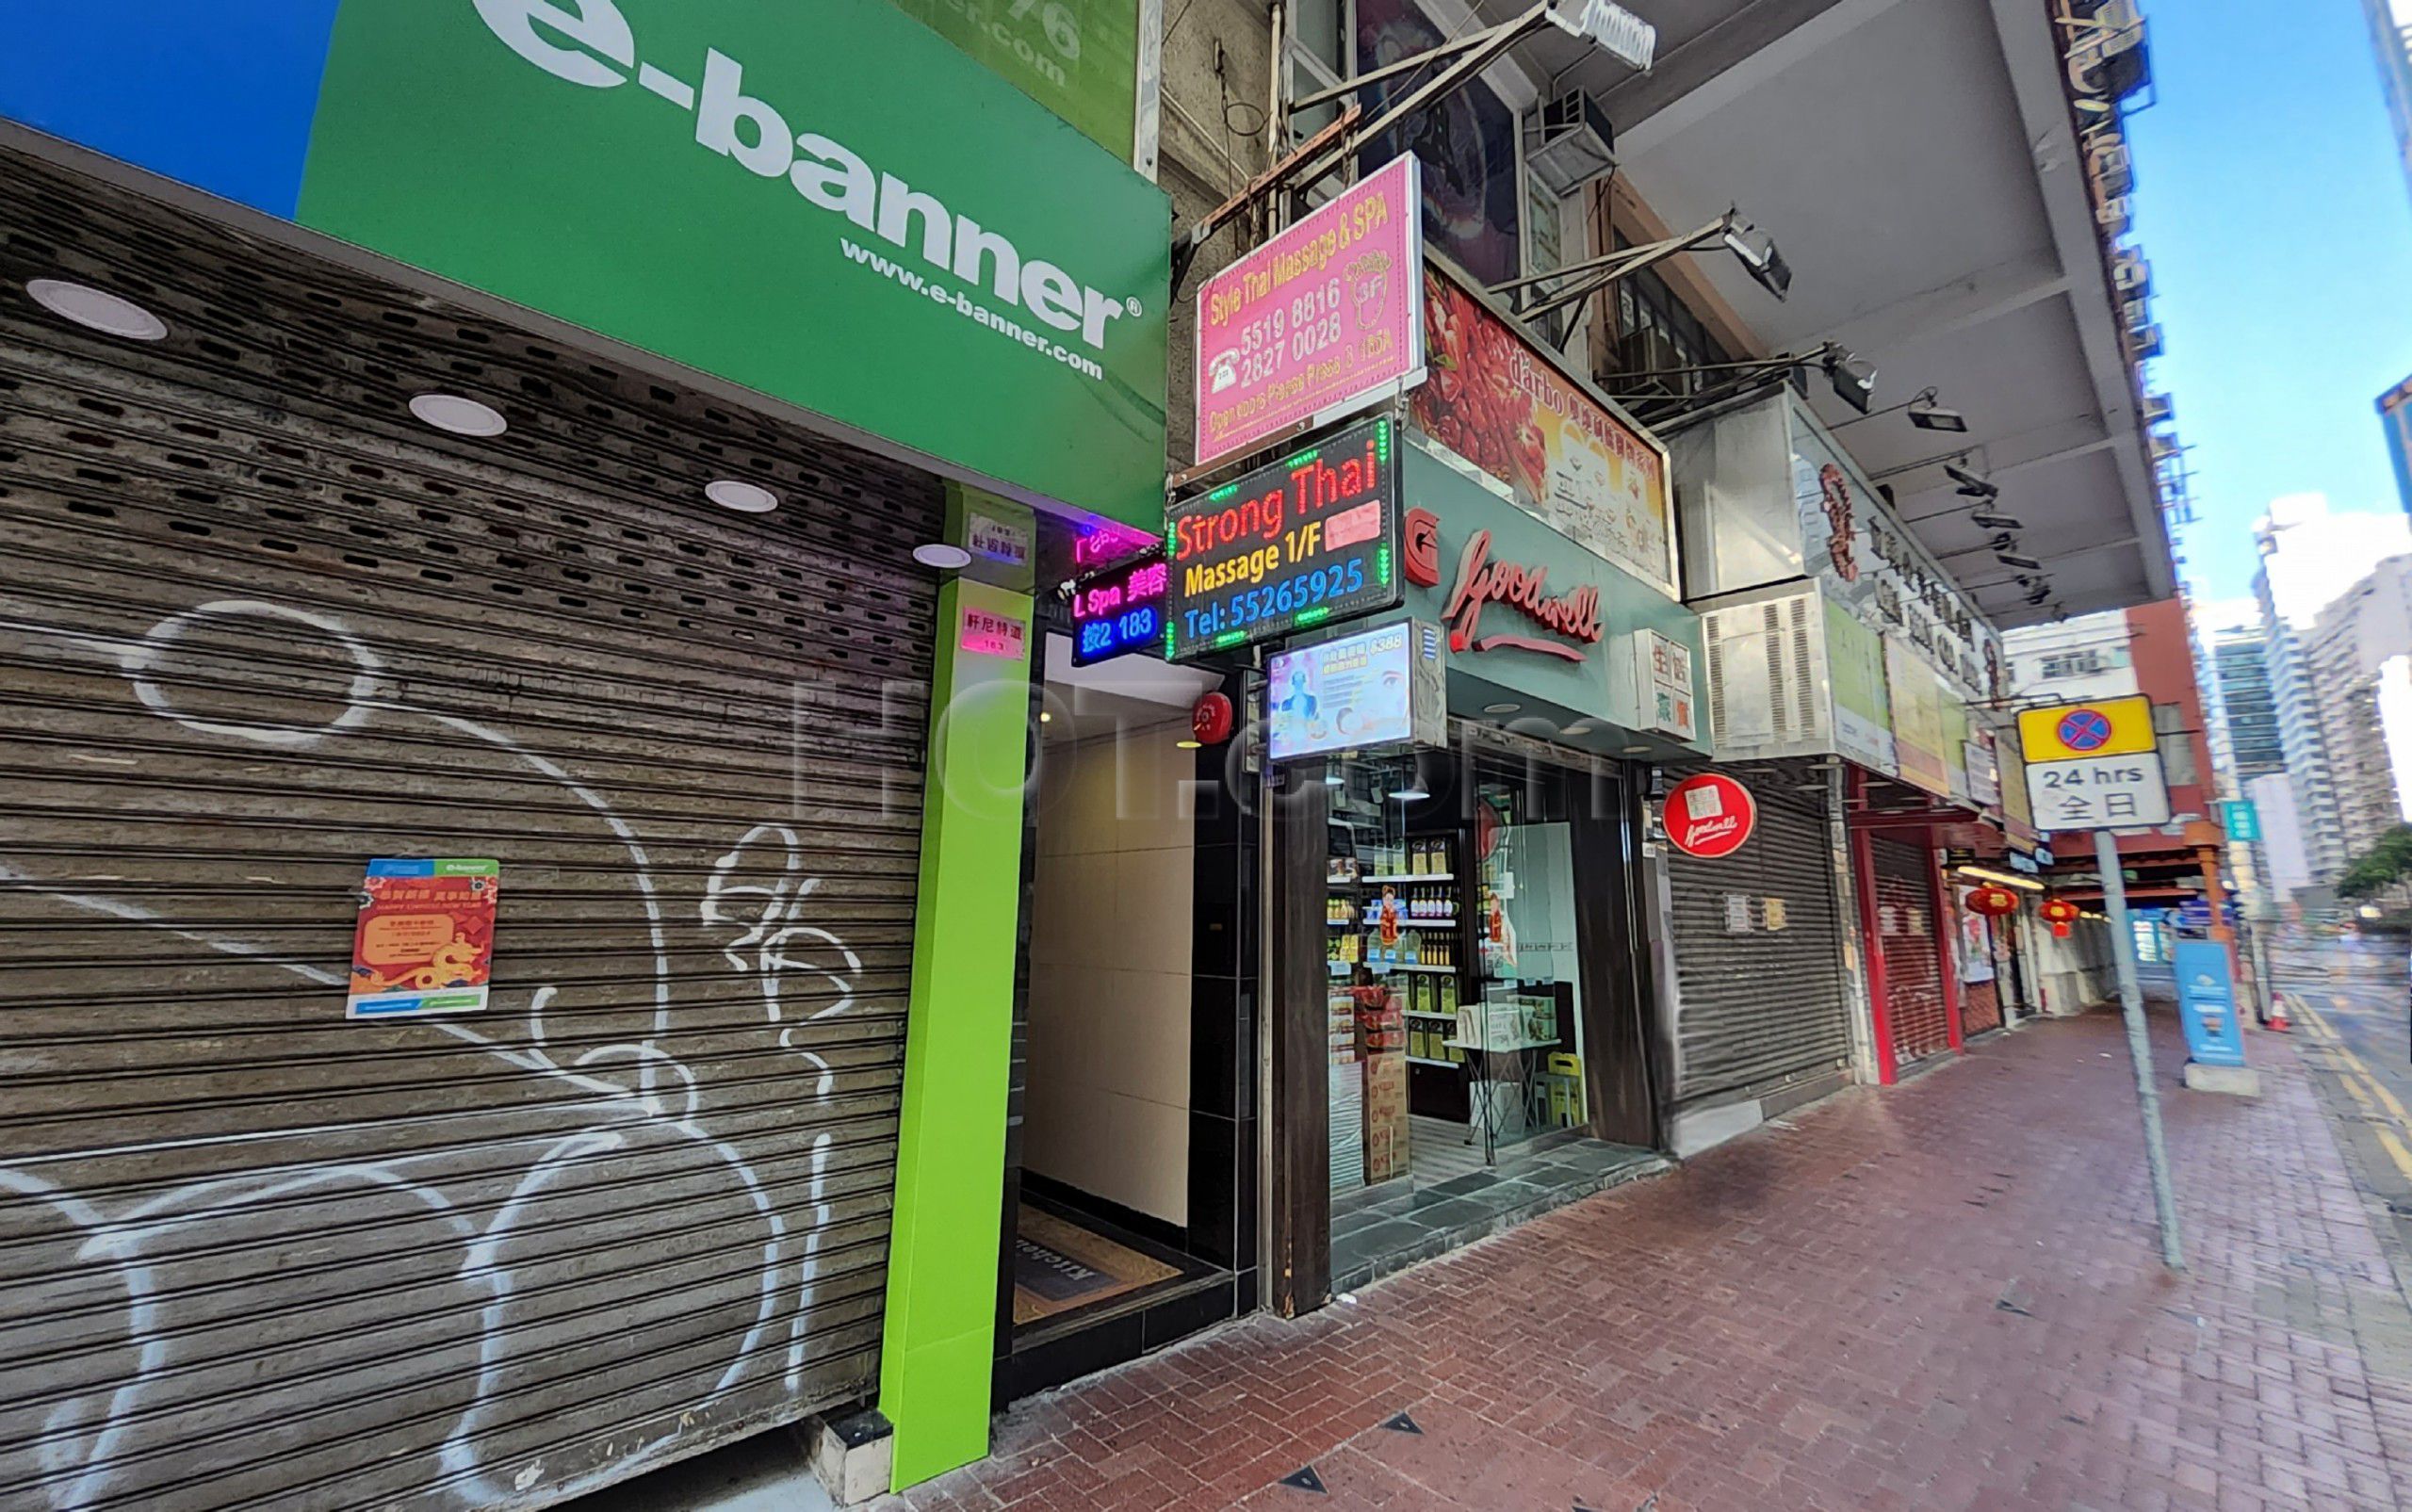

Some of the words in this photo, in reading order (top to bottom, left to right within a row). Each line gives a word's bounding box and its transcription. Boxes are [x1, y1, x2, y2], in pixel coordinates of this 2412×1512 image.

[472, 0, 1123, 350] e-banner
[1210, 285, 1242, 327] Style
[1243, 267, 1271, 305] Thai
[1272, 228, 1337, 287] Massage
[1338, 212, 1351, 251] &
[1352, 192, 1390, 241] SPA
[840, 236, 1102, 381] www.e-banner.com
[1240, 308, 1285, 355] 5519
[1291, 278, 1341, 329] 8816
[1240, 339, 1286, 388] 2827
[1291, 311, 1341, 362] 0028
[1176, 489, 1283, 561] Strong
[1291, 439, 1377, 514] Thai
[1073, 593, 1086, 618] L
[1087, 586, 1121, 616] Spa
[1127, 562, 1167, 602] 美容
[1184, 544, 1280, 598] Massage
[1285, 521, 1322, 563] 1/F
[1118, 608, 1152, 640] 183
[2043, 768, 2085, 789] 24
[2092, 766, 2143, 785] hrs
[2058, 792, 2138, 821] 全日
